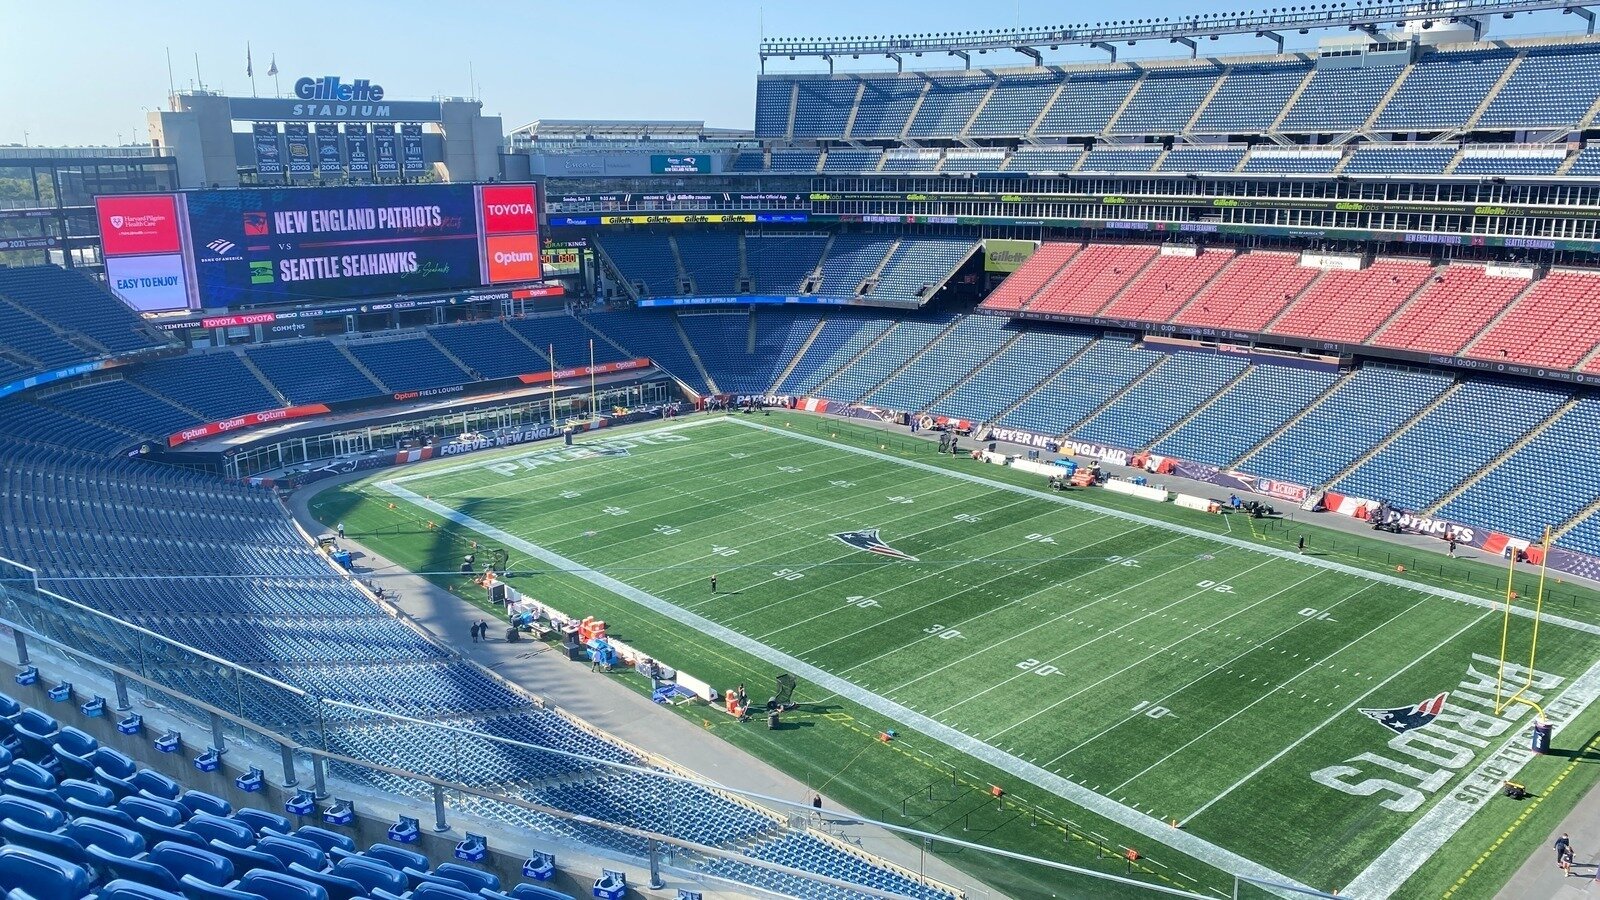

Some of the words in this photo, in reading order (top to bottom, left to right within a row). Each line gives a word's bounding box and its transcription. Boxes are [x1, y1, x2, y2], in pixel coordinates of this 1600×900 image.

[295, 76, 384, 101] Gillette
[293, 105, 390, 117] STADIUM
[565, 158, 603, 168] Encore
[488, 204, 533, 216] TOYOTA
[1336, 202, 1380, 210] GilletteLabs
[1475, 206, 1524, 216] GilletteLabs
[274, 211, 308, 234] NEW
[311, 208, 376, 232] ENGLAND
[378, 205, 442, 230] PATRIOTS
[1416, 234, 1438, 242] ENGLAND
[1438, 235, 1462, 244] PATRIOTS
[1505, 238, 1525, 247] SEATTLE
[1526, 240, 1555, 249] SEAHAWKS
[494, 251, 533, 266] Optum
[990, 251, 1028, 262] Gillette
[280, 256, 340, 282] SEATTLE
[342, 252, 418, 278] SEAHAWKS
[118, 279, 138, 289] EASY
[139, 278, 151, 288] TO
[153, 276, 178, 287] ENJOY
[204, 318, 237, 328] TOYOTA
[241, 314, 273, 324] TOYOTA
[616, 360, 636, 370] Optum
[1440, 356, 1452, 364] SEA
[1457, 359, 1476, 368] 0:00
[554, 370, 576, 378] Optum
[585, 365, 606, 375] Optum
[394, 392, 418, 401] Optum
[438, 386, 464, 394] LOUNGE
[257, 410, 286, 422] Optum
[219, 418, 244, 430] Optum
[182, 427, 208, 440] Optum
[441, 438, 494, 456] FOREVER
[496, 432, 524, 446] NEW
[1033, 434, 1062, 450] NEW
[1064, 440, 1127, 462] ENGLAND
[1272, 483, 1302, 498] KICKOFF
[1388, 511, 1474, 542] PATRIOTS
[1025, 534, 1054, 542] 40
[712, 546, 740, 556] 40
[1104, 554, 1139, 566] 30
[772, 568, 804, 580] 50
[1196, 580, 1233, 592] 20
[846, 596, 878, 608] 40
[1298, 608, 1330, 620] 10
[924, 624, 960, 639] 30
[1016, 658, 1058, 676] 20
[1132, 701, 1170, 718] 10
[1310, 652, 1566, 812] PATRIOTS
[1494, 740, 1530, 764] ALL
[1478, 766, 1508, 785] OF
[1454, 784, 1489, 805] US
